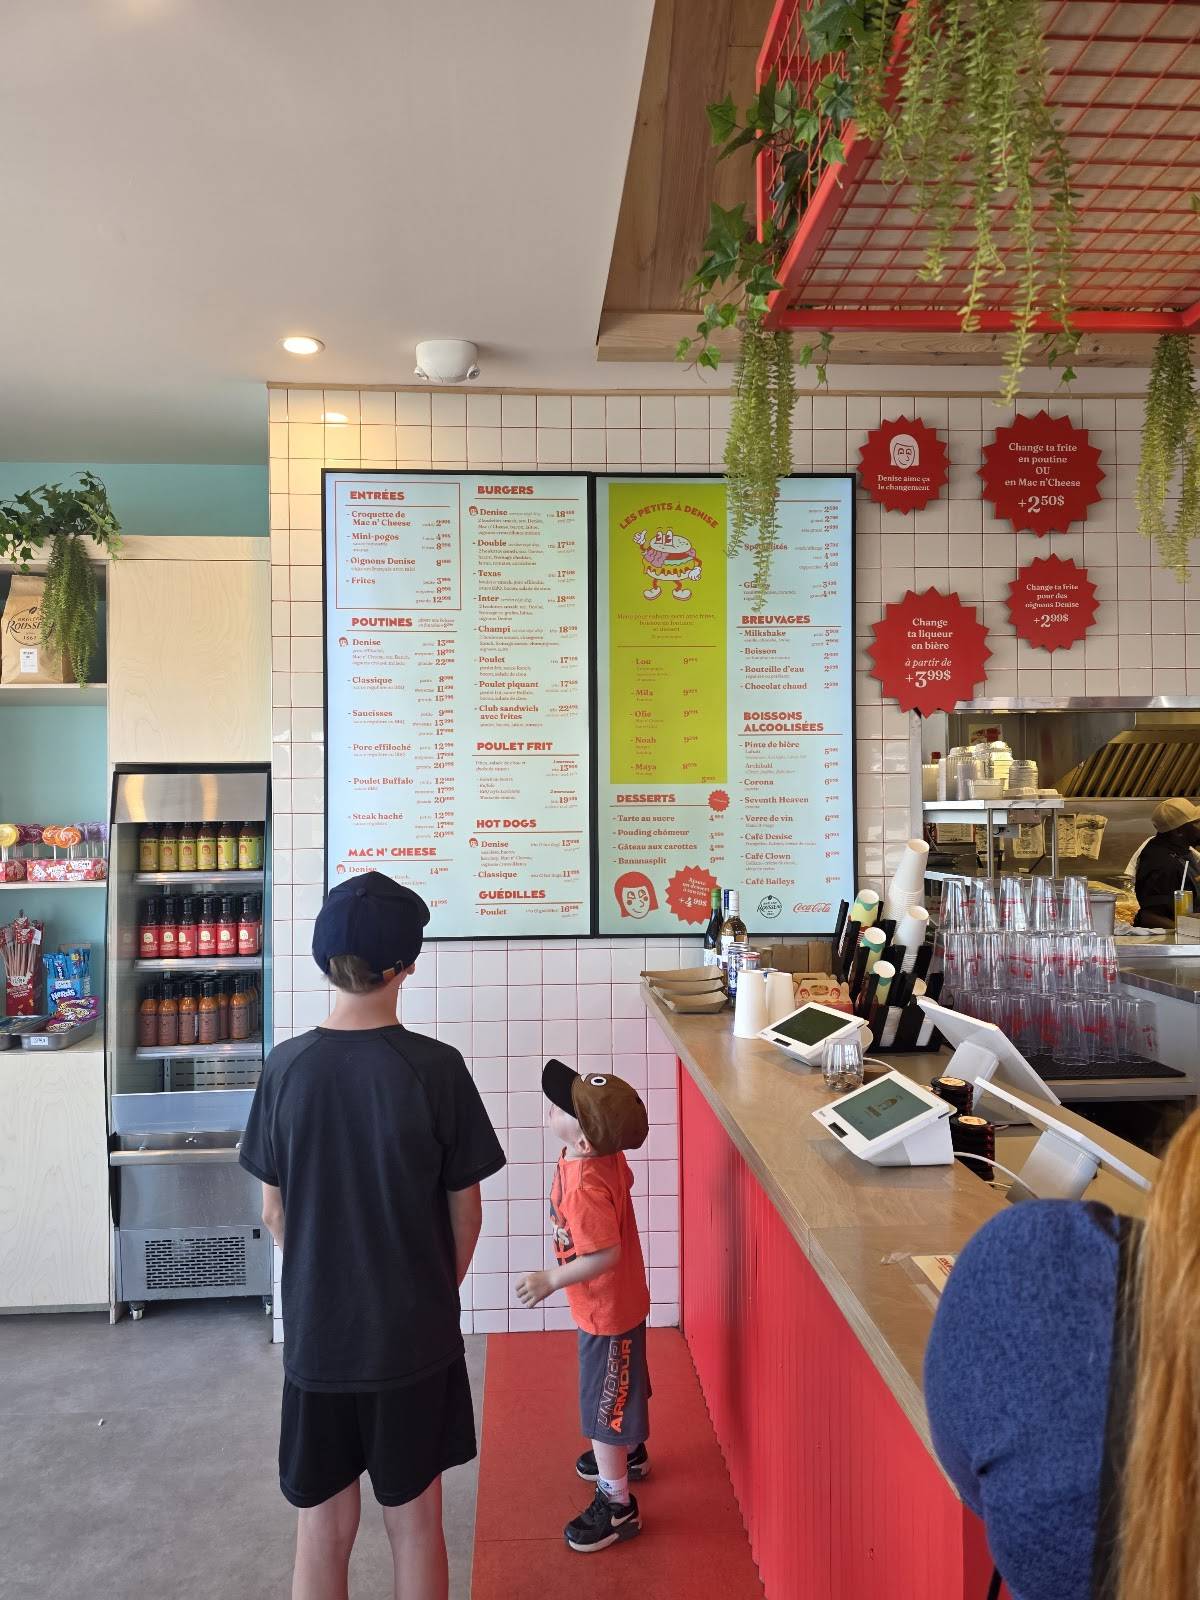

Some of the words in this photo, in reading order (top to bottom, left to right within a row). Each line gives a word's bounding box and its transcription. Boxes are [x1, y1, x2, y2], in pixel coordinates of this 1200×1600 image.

[1008, 442, 1042, 453] Change
[1057, 443, 1078, 452] frite
[1032, 455, 1068, 465] poutine
[1035, 467, 1051, 475] OU
[1018, 478, 1040, 486] Mac
[477, 485, 534, 495] BURGERS
[885, 484, 930, 492] changement
[350, 489, 405, 501] ENTRÉES
[352, 510, 394, 519] Croquette
[480, 508, 508, 516] Denise
[619, 512, 638, 530] LES
[638, 502, 673, 518] PETITS
[684, 505, 719, 529] DENISE
[381, 519, 411, 527] Cheese
[352, 532, 400, 542] Mini-pogos
[351, 557, 385, 565] Oignons
[387, 557, 416, 565] Denise
[477, 569, 502, 577] Texas
[351, 617, 413, 627] POUTINES
[741, 615, 811, 624] BREUVAGES
[912, 618, 948, 628] Change
[478, 625, 511, 635] Champi
[744, 629, 786, 637] Milkshake
[919, 630, 953, 639] liqueur
[352, 638, 382, 646] Denise
[925, 642, 950, 650] bière
[744, 647, 777, 655] Boisson
[912, 658, 939, 668] partir
[942, 658, 952, 666] de
[782, 665, 805, 673] d'eau
[352, 676, 393, 686] Classique
[479, 680, 506, 688] Poulet
[508, 681, 539, 690] piquant
[352, 709, 393, 717] Saucisses
[743, 712, 803, 721] BOISSONS
[744, 721, 825, 732] ALCOOLISÉES
[635, 736, 657, 744] Noah
[374, 743, 412, 751] effiloché
[477, 742, 525, 751] POULET
[526, 742, 553, 751] FRIT
[635, 763, 657, 771] Maya
[353, 777, 381, 785] Poulet
[382, 777, 414, 785] Buffalo
[616, 794, 676, 803] DESSERTS
[744, 796, 777, 804] Seventh
[378, 812, 404, 820] haché
[617, 814, 640, 822] Tarte
[770, 814, 780, 822] de
[476, 819, 501, 828] HOT
[503, 819, 537, 828] DOGS
[617, 829, 652, 837] Pouding
[480, 840, 509, 848] Denise
[348, 848, 374, 857] MAC
[390, 847, 437, 857] CHEESE
[745, 852, 764, 860] Café
[478, 871, 518, 879] Classique
[766, 878, 795, 886] Baileys
[478, 888, 546, 899] GUÉDILLES
[480, 908, 507, 916] Poulet
[50, 989, 76, 1000] Nerds
[597, 1340, 620, 1428] UNDER
[610, 1339, 633, 1433] ARMOUR
